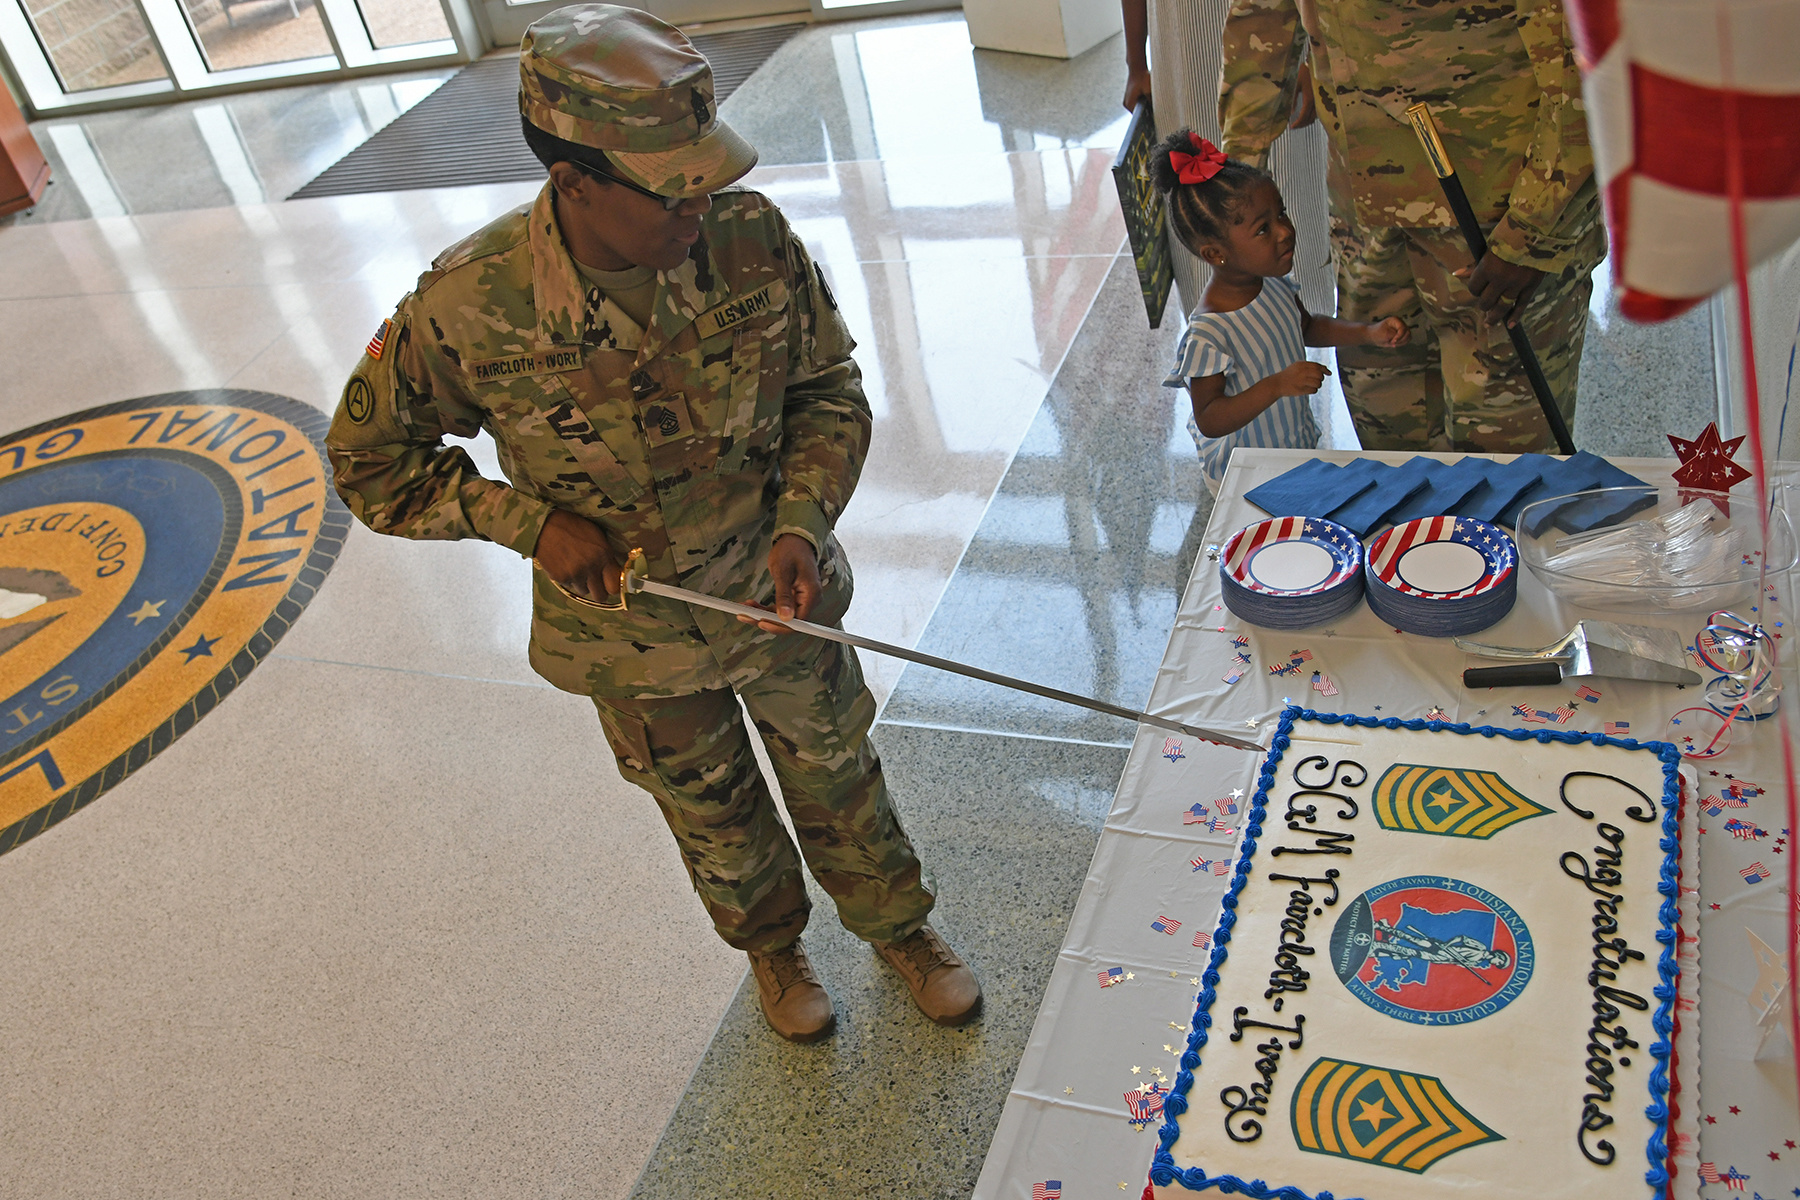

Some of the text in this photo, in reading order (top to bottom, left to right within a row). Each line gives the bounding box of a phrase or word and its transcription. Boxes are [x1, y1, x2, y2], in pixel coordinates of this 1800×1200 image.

[475, 357, 536, 379] FAIRCLOTH
[545, 351, 578, 369] IVORY
[128, 409, 315, 592] NATIONAL
[1271, 755, 1368, 857] SGM
[1370, 877, 1437, 898] ALWAYS READY
[1339, 901, 1362, 975] PROTECT WHAT MATTERS
[1436, 884, 1533, 1025] LOUISIANA NATIONAL GUARD
[1559, 771, 1657, 1166] Congratulations
[1350, 984, 1416, 1021] ALWAYS THERE
